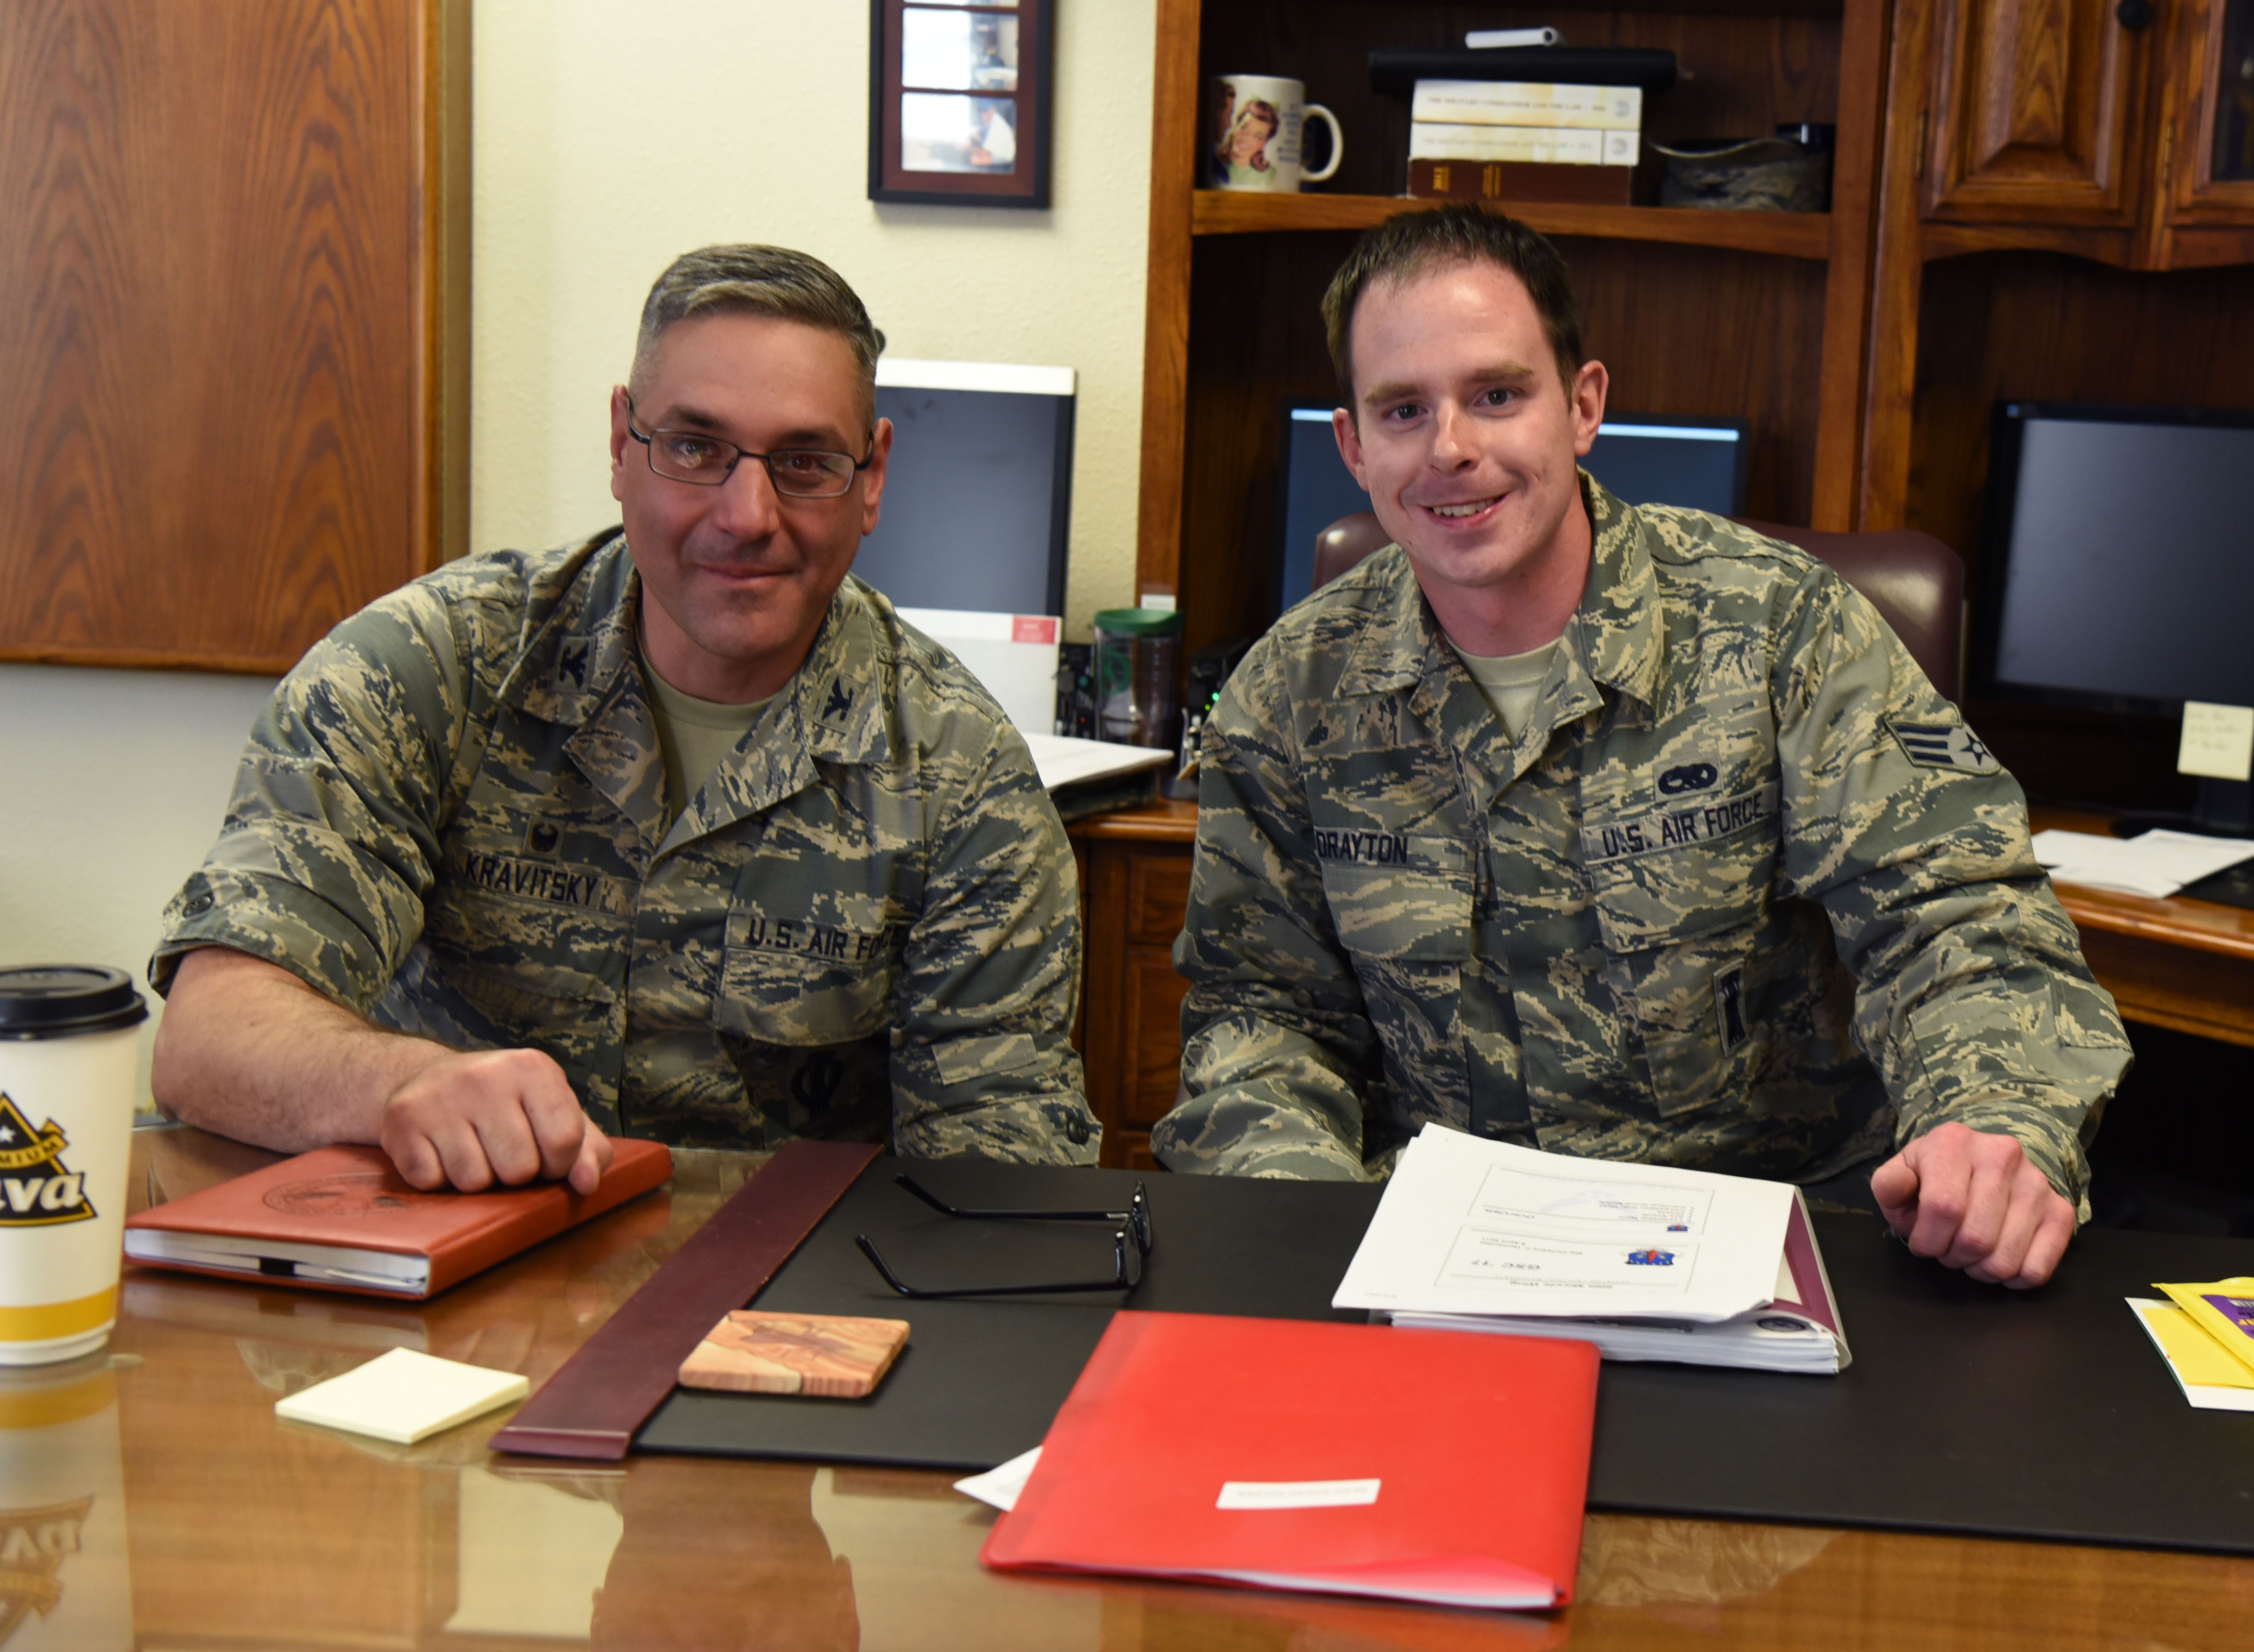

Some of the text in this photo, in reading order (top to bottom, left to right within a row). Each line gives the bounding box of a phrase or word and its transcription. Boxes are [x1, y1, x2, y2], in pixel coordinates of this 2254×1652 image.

[1602, 791, 1763, 857] U.S. AIR FORCE
[1315, 831, 1408, 863] DRAYTON
[465, 852, 599, 906] KRAVITSKY
[749, 917, 800, 949] U.S.
[808, 926, 849, 959] AIR
[0, 1173, 85, 1212] va
